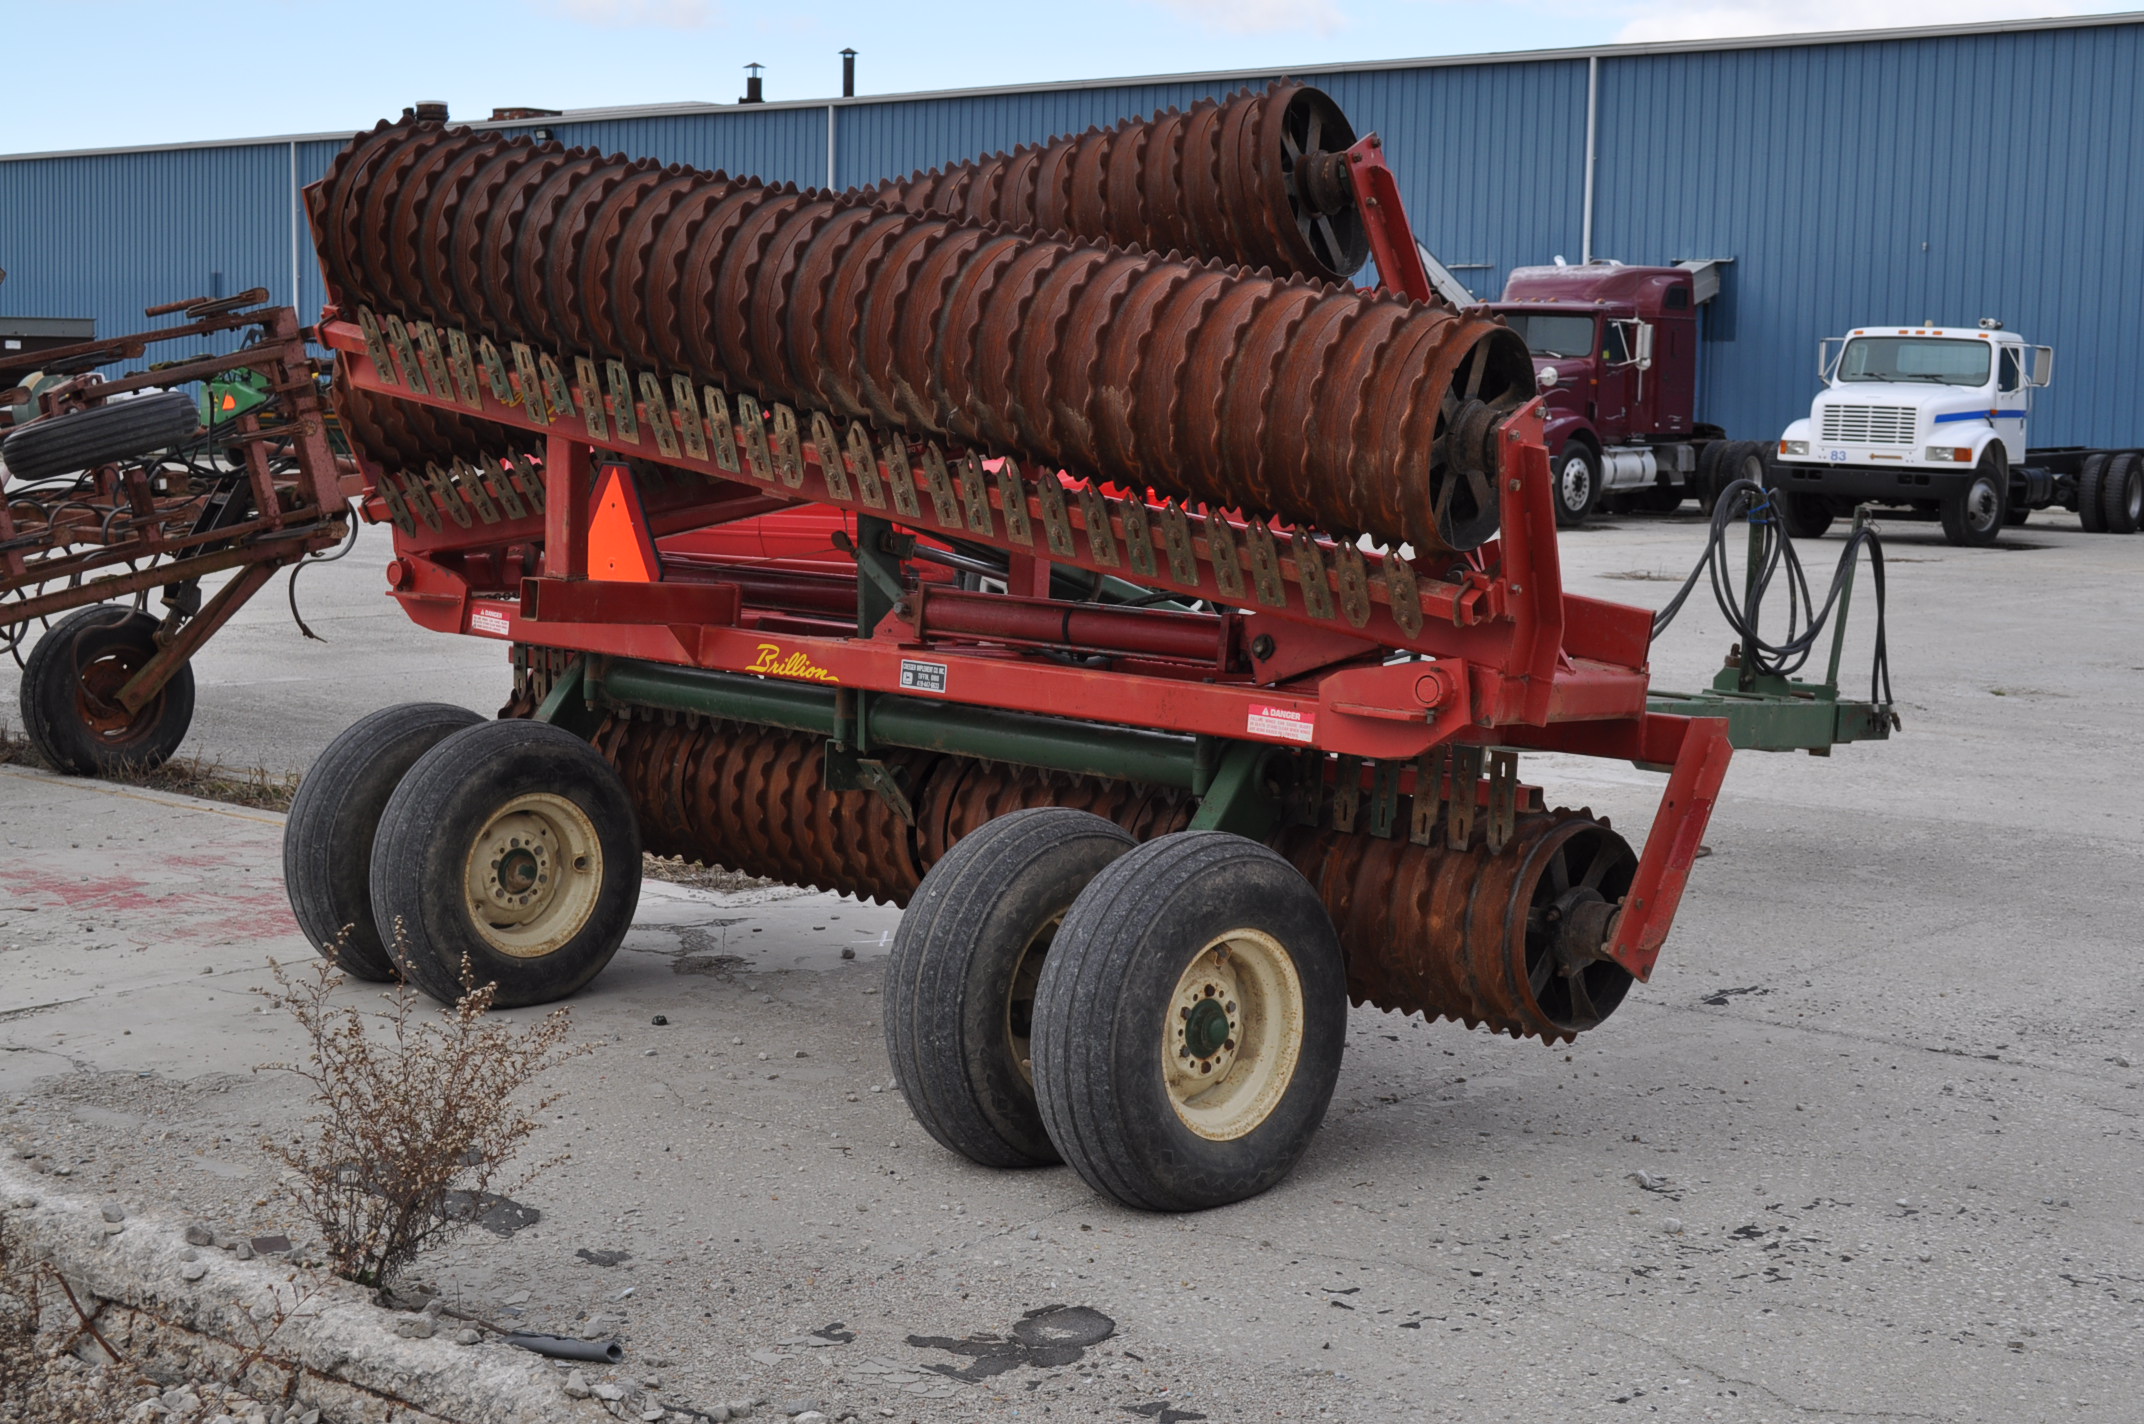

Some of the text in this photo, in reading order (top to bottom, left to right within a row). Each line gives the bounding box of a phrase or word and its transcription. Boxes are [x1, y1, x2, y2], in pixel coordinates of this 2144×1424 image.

[1830, 450, 1846, 461] 83
[744, 644, 840, 682] Brillion
[1270, 709, 1301, 720] DANGER
